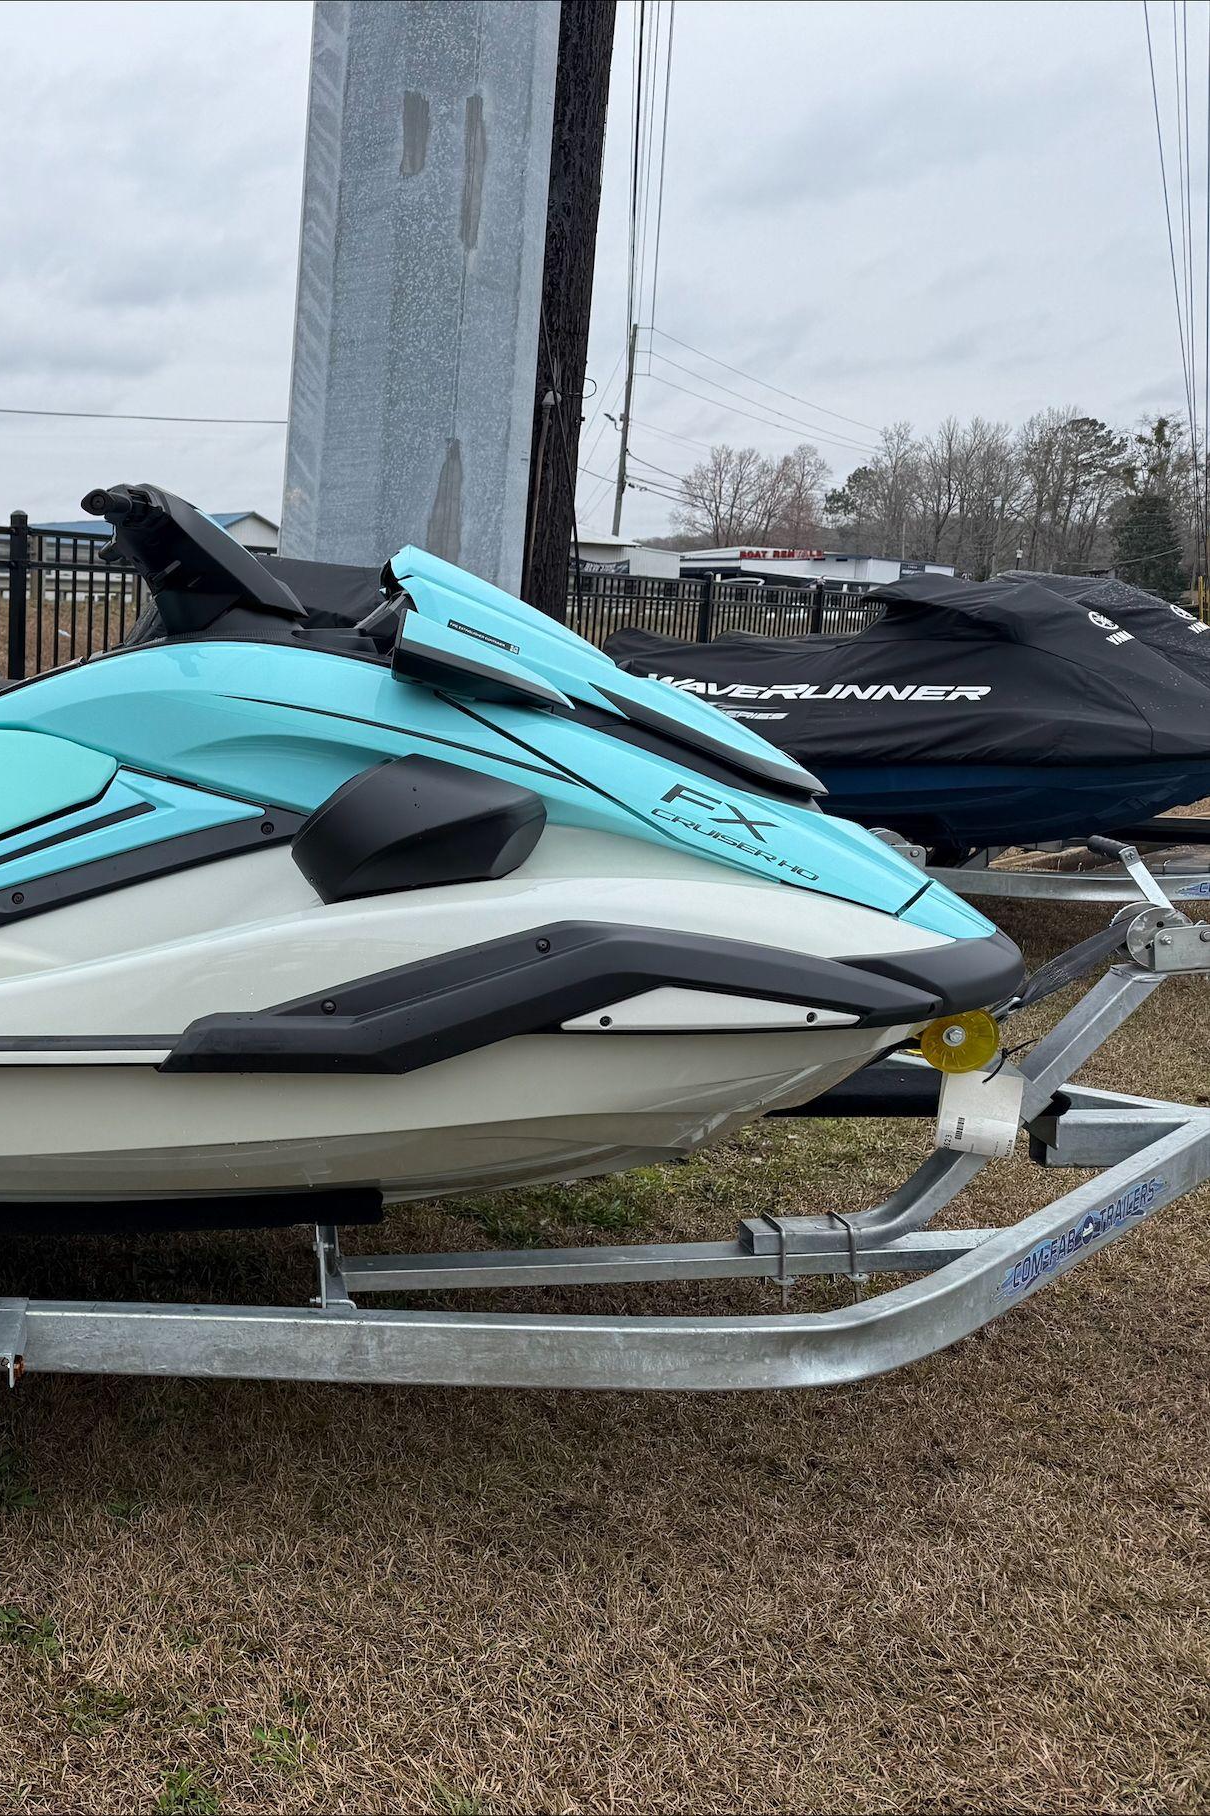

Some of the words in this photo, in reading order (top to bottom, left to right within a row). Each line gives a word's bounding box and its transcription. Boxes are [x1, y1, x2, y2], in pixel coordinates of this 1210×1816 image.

[740, 550, 768, 559] BOAT
[773, 549, 823, 558] RENTALS
[659, 783, 782, 845] FX
[651, 807, 777, 864] CRUISER
[777, 859, 820, 882] HO
[1099, 1178, 1156, 1233] TRAILERS
